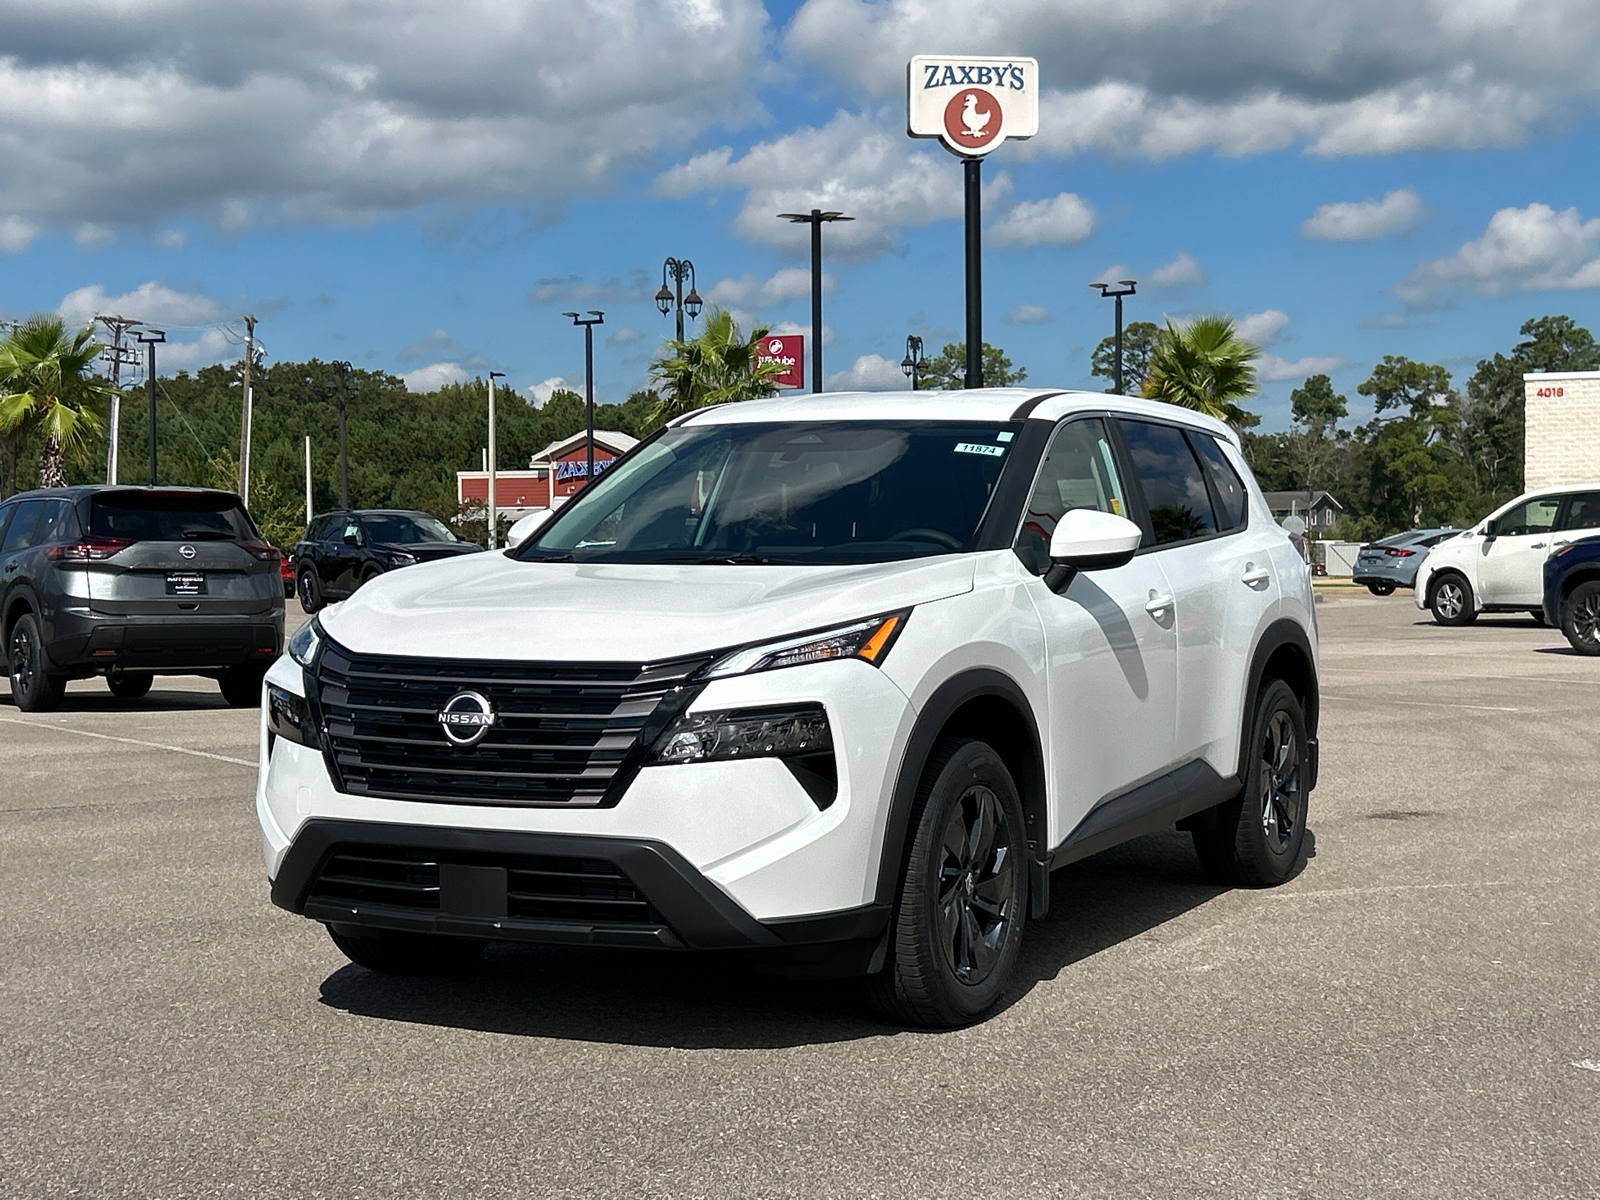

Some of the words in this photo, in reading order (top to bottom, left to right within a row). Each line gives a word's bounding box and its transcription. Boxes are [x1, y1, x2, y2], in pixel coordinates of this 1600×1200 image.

[924, 63, 1024, 90] ZAXBY'S
[1536, 387, 1564, 398] 4018
[962, 444, 996, 454] 11874
[438, 713, 494, 725] NISSAN
